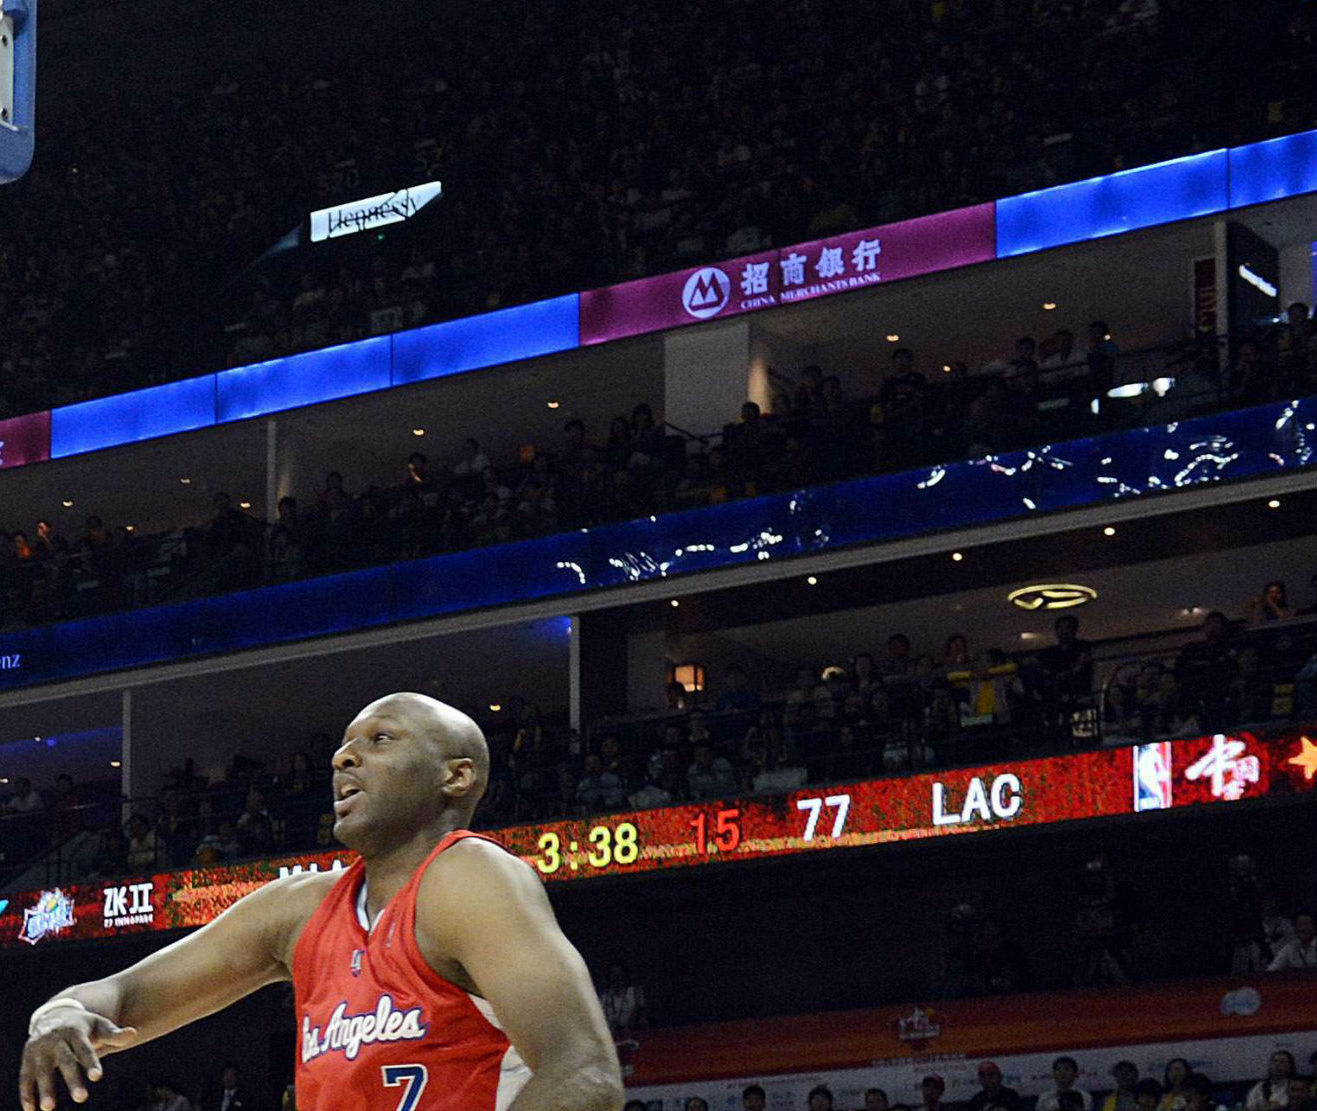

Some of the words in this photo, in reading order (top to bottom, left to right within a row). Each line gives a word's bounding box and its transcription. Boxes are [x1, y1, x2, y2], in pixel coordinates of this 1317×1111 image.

[741, 295, 775, 309] CHINA
[849, 272, 881, 287] BANK
[537, 822, 639, 874] 3:38
[690, 809, 741, 855] 15
[796, 794, 851, 842] 77
[931, 773, 1023, 826] LAC
[322, 995, 427, 1061] Angeles
